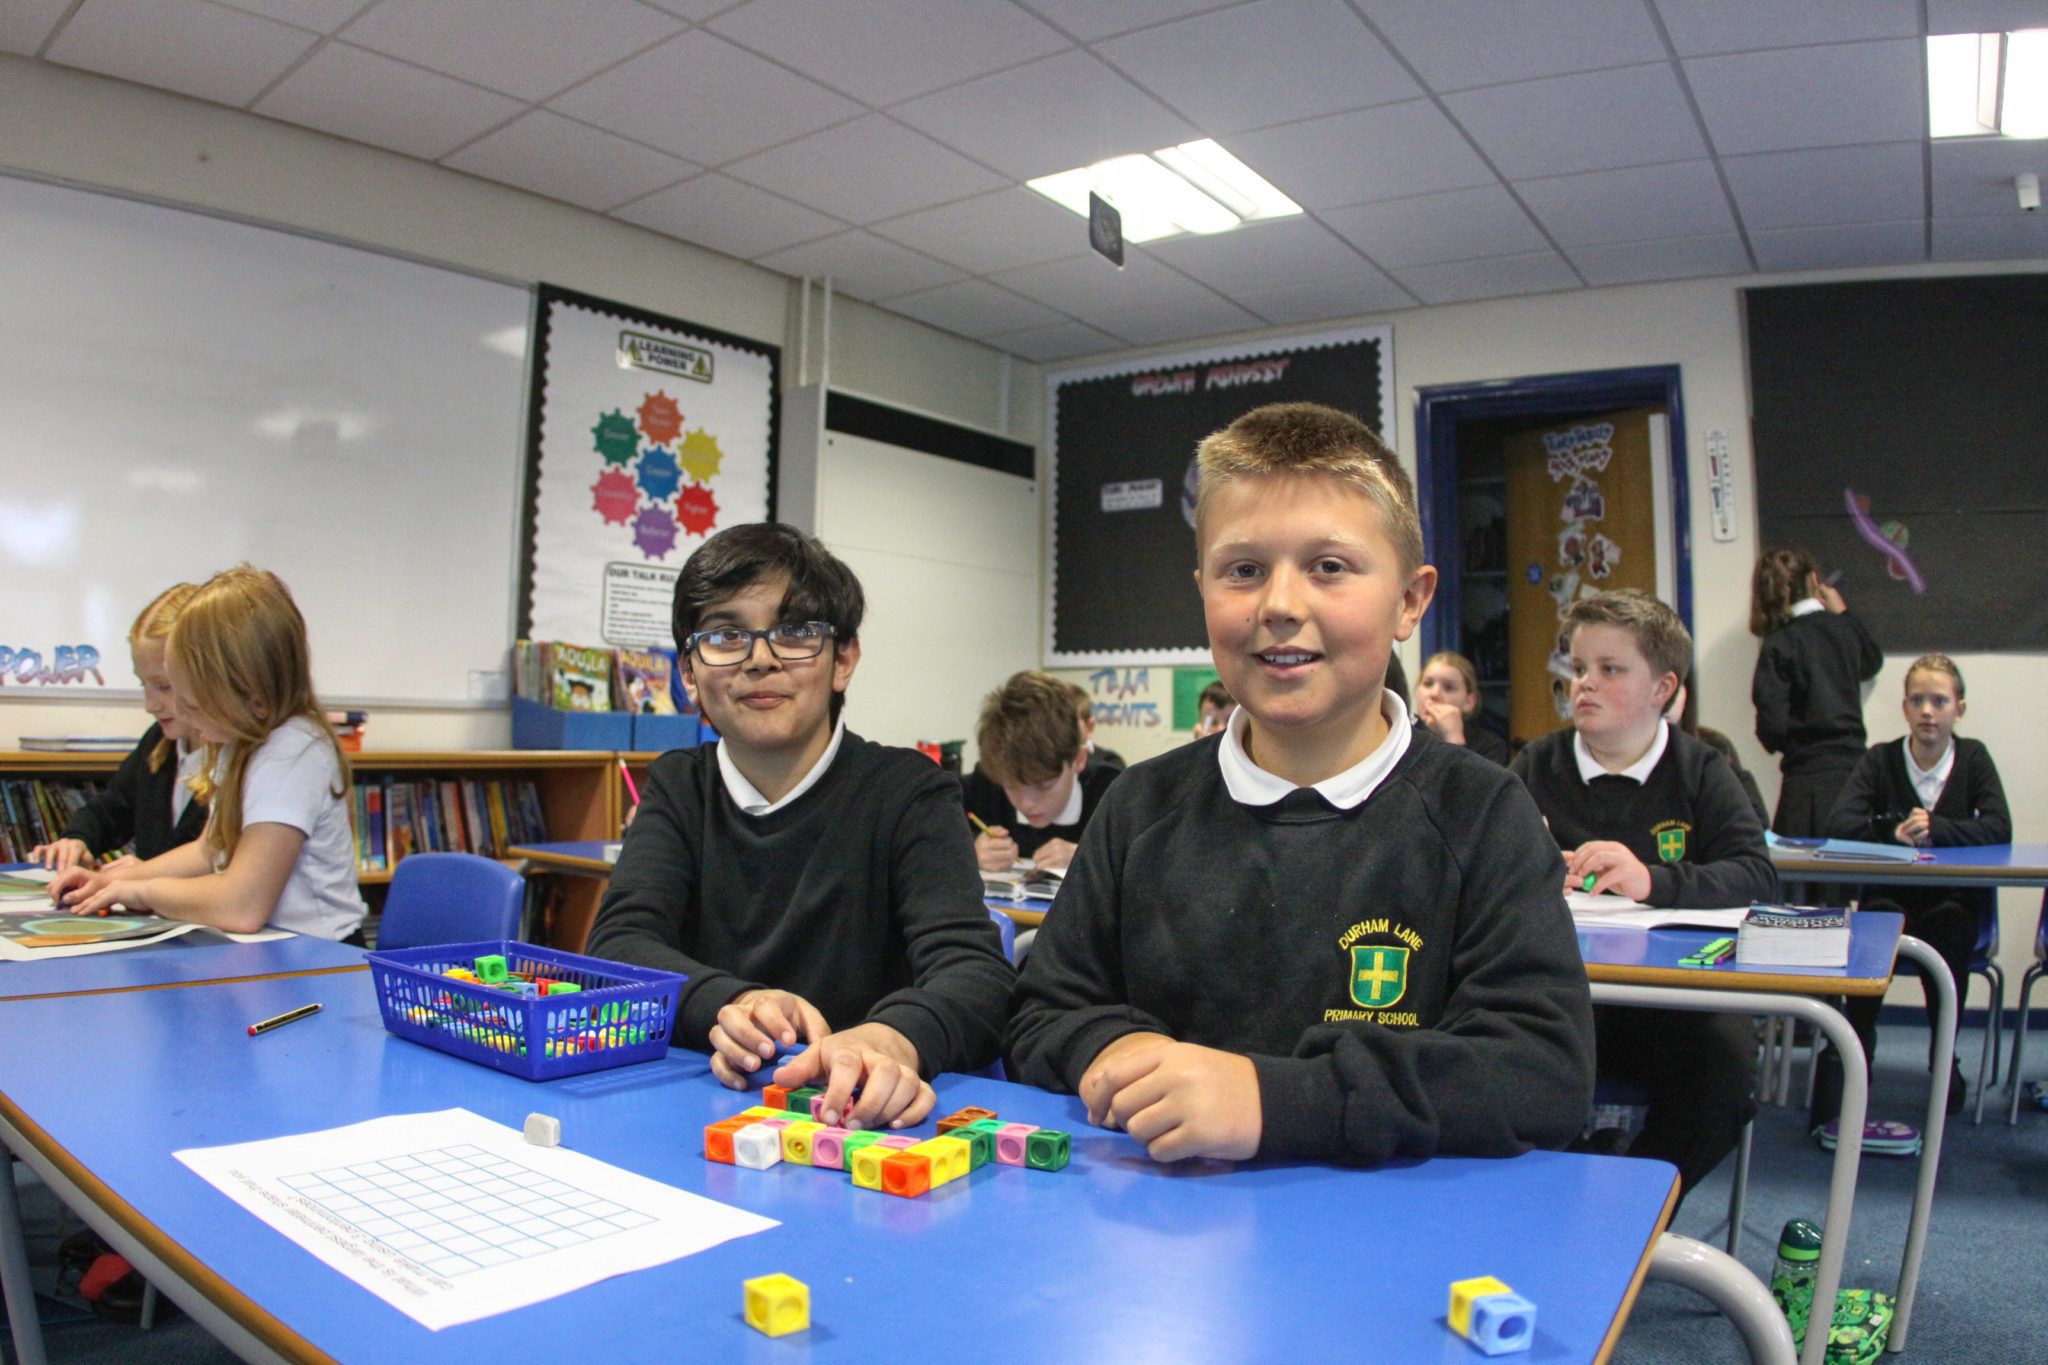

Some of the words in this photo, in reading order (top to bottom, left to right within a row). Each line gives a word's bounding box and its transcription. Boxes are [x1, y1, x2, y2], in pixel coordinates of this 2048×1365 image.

[639, 341, 696, 362] LEARNING
[647, 352, 687, 371] POWER
[1131, 370, 1196, 396] GROWTH
[1205, 359, 1291, 391] MINDSET
[609, 568, 629, 578] OUR
[632, 570, 656, 580] TALK
[1338, 918, 1389, 950] DURHAM
[1393, 923, 1424, 951] LANE
[1323, 1008, 1375, 1022] PRIMARY
[1377, 1011, 1420, 1027] SCHOOL
[361, 1256, 384, 1270] the
